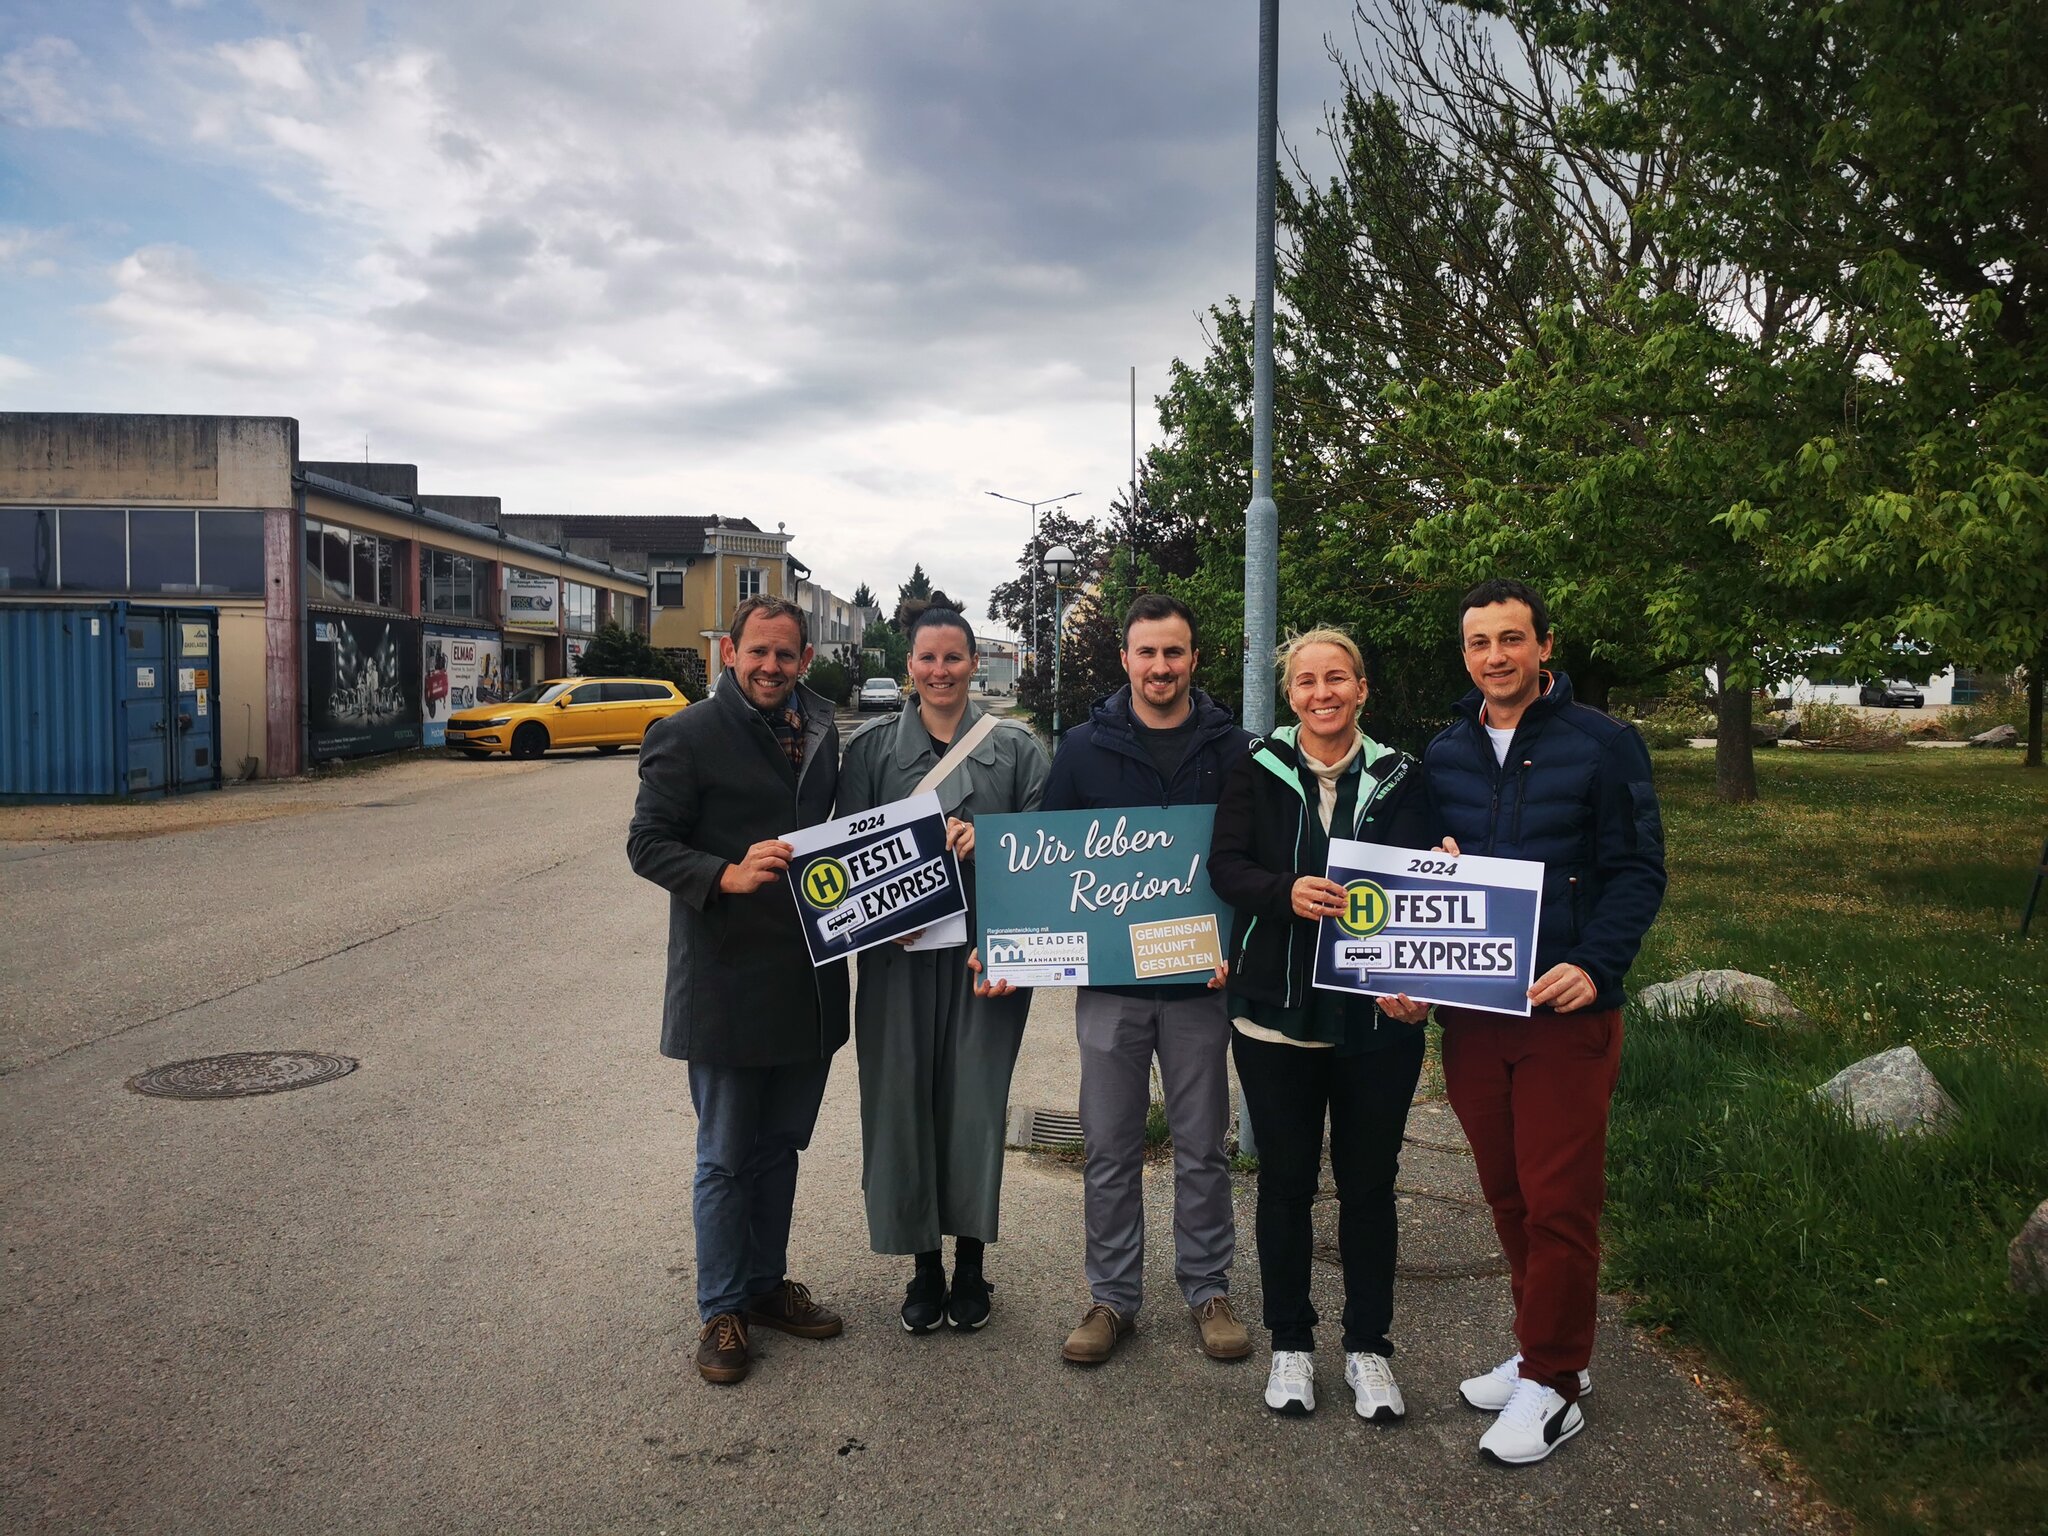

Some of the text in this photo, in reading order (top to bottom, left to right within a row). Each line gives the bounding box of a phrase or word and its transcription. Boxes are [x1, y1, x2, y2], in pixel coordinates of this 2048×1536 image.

[453, 646, 474, 661] ELMAG
[848, 813, 886, 836] 2024
[1000, 815, 1175, 873] Wir leben
[846, 836, 912, 883] FESTL
[1407, 859, 1459, 876] 2024
[811, 866, 840, 900] H
[860, 860, 947, 920] EXPRESS
[1069, 853, 1201, 917] Region!
[1350, 893, 1374, 924] H
[1394, 894, 1476, 924] FESTL
[986, 927, 1040, 935] Regionalentwicklung
[1028, 935, 1085, 946] LEADER
[1135, 920, 1213, 941] GEMEINSAM
[1137, 938, 1196, 957] ZUKUNFT
[1394, 940, 1513, 972] EXPRESS
[1139, 952, 1214, 972] GESTALTEN
